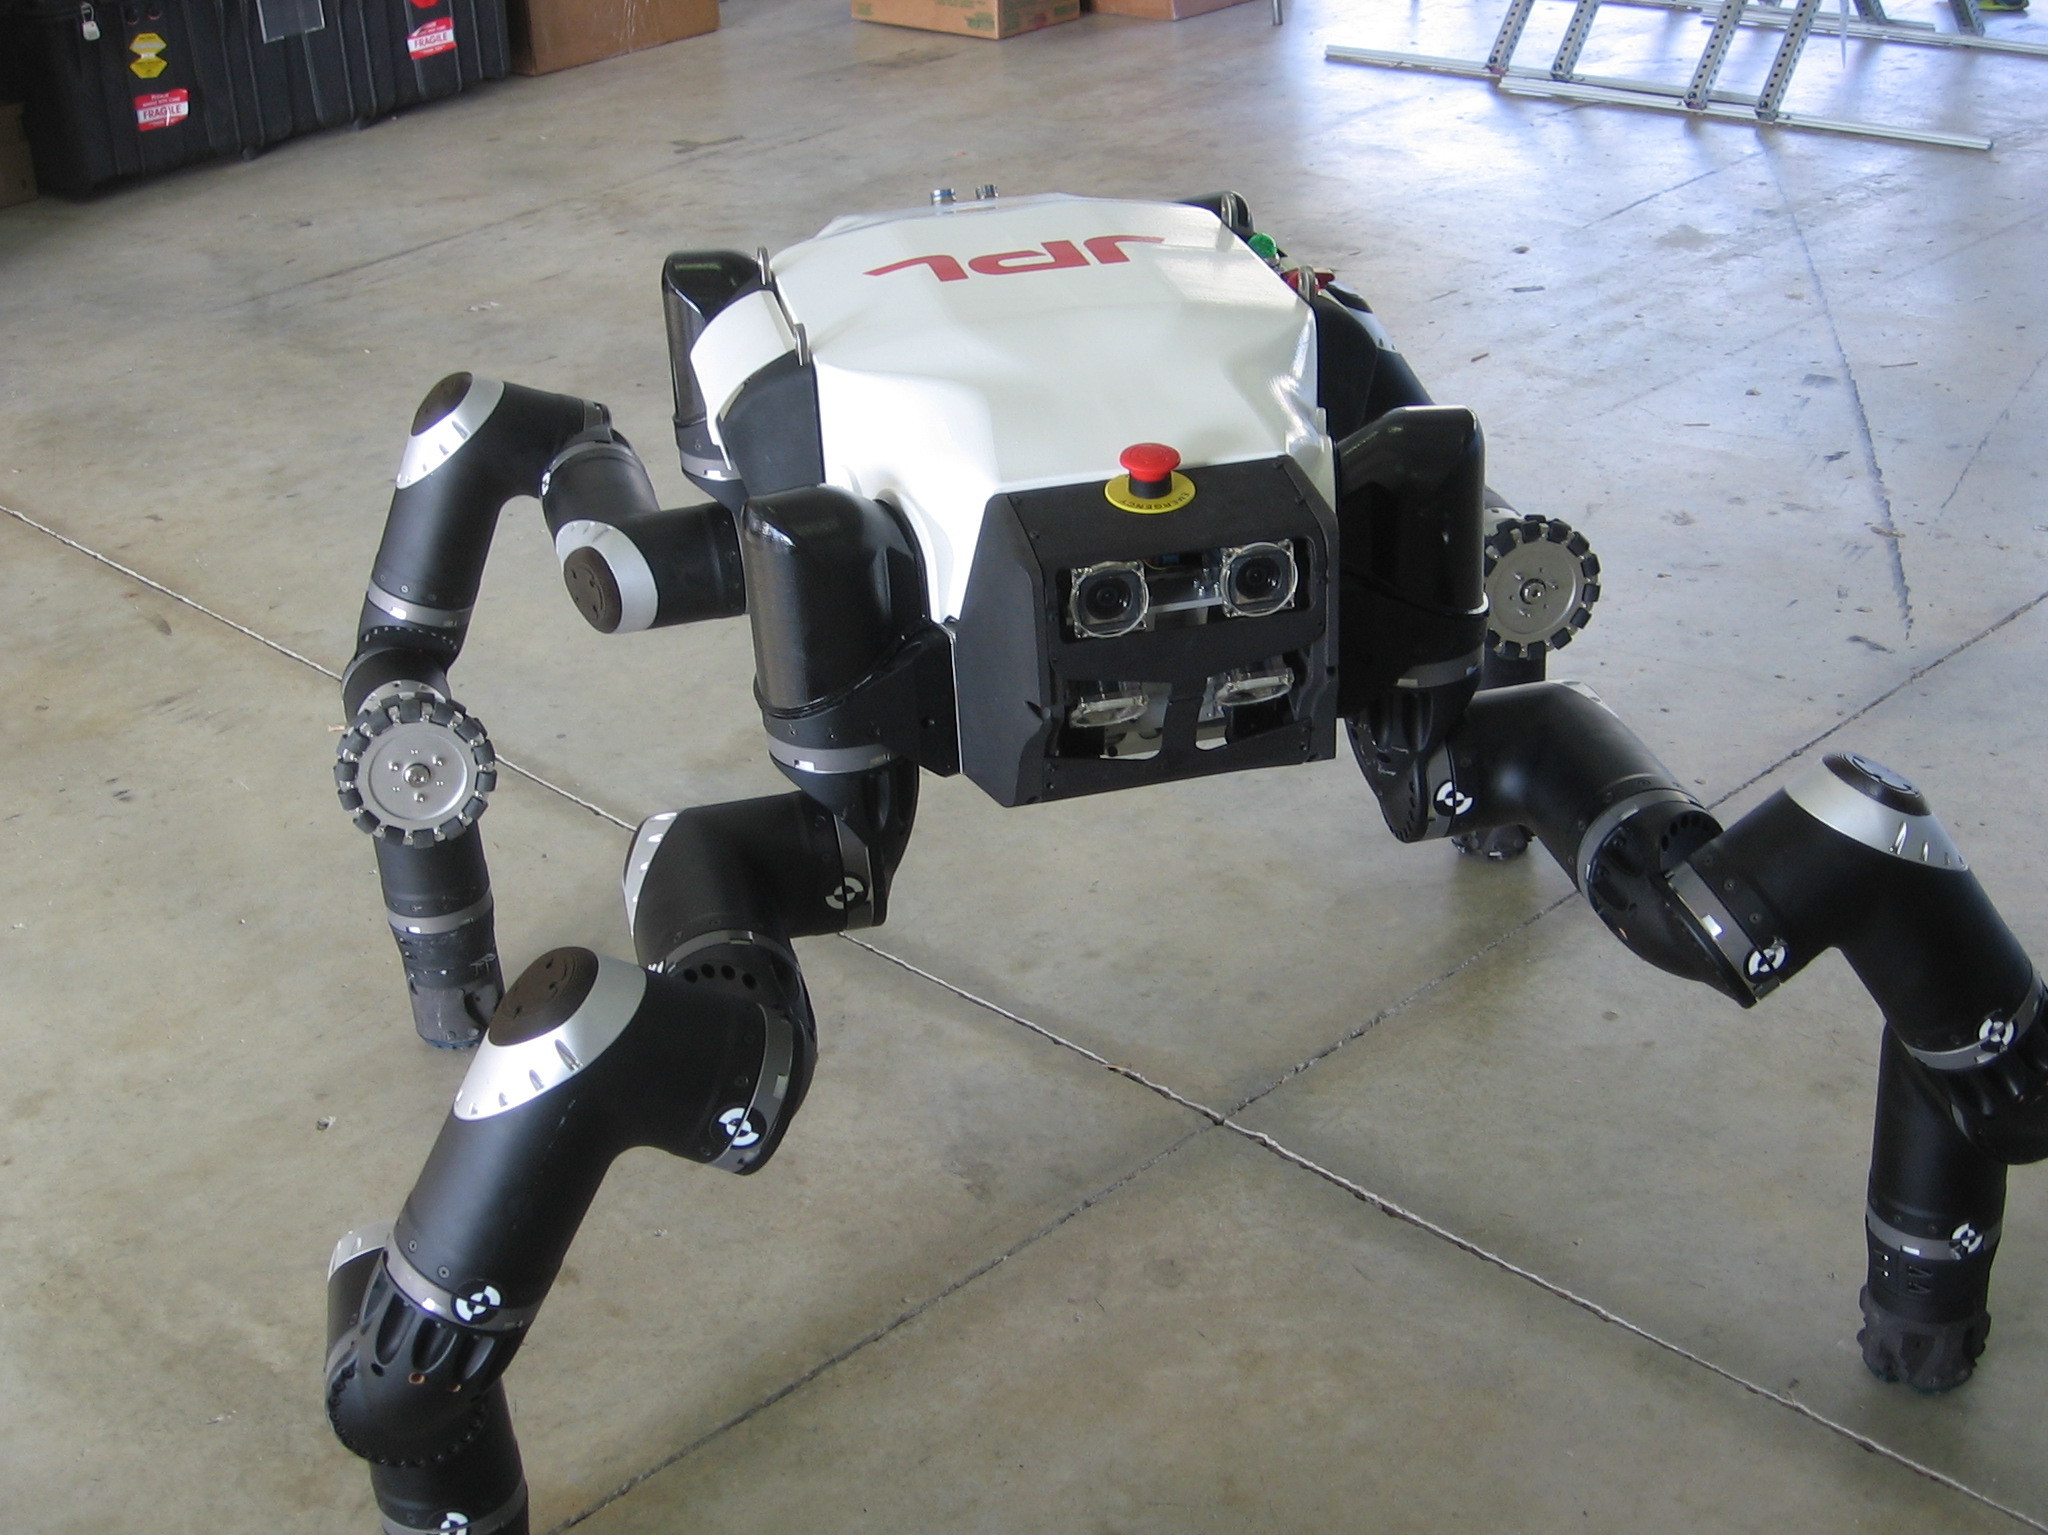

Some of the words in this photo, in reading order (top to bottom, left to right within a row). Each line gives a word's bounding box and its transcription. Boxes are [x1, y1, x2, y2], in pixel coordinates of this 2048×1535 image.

[415, 31, 448, 49] FRAGILE
[143, 103, 181, 120] FRAGILE
[863, 235, 1165, 282] JPL
[1121, 492, 1190, 510] EMERGENCY
